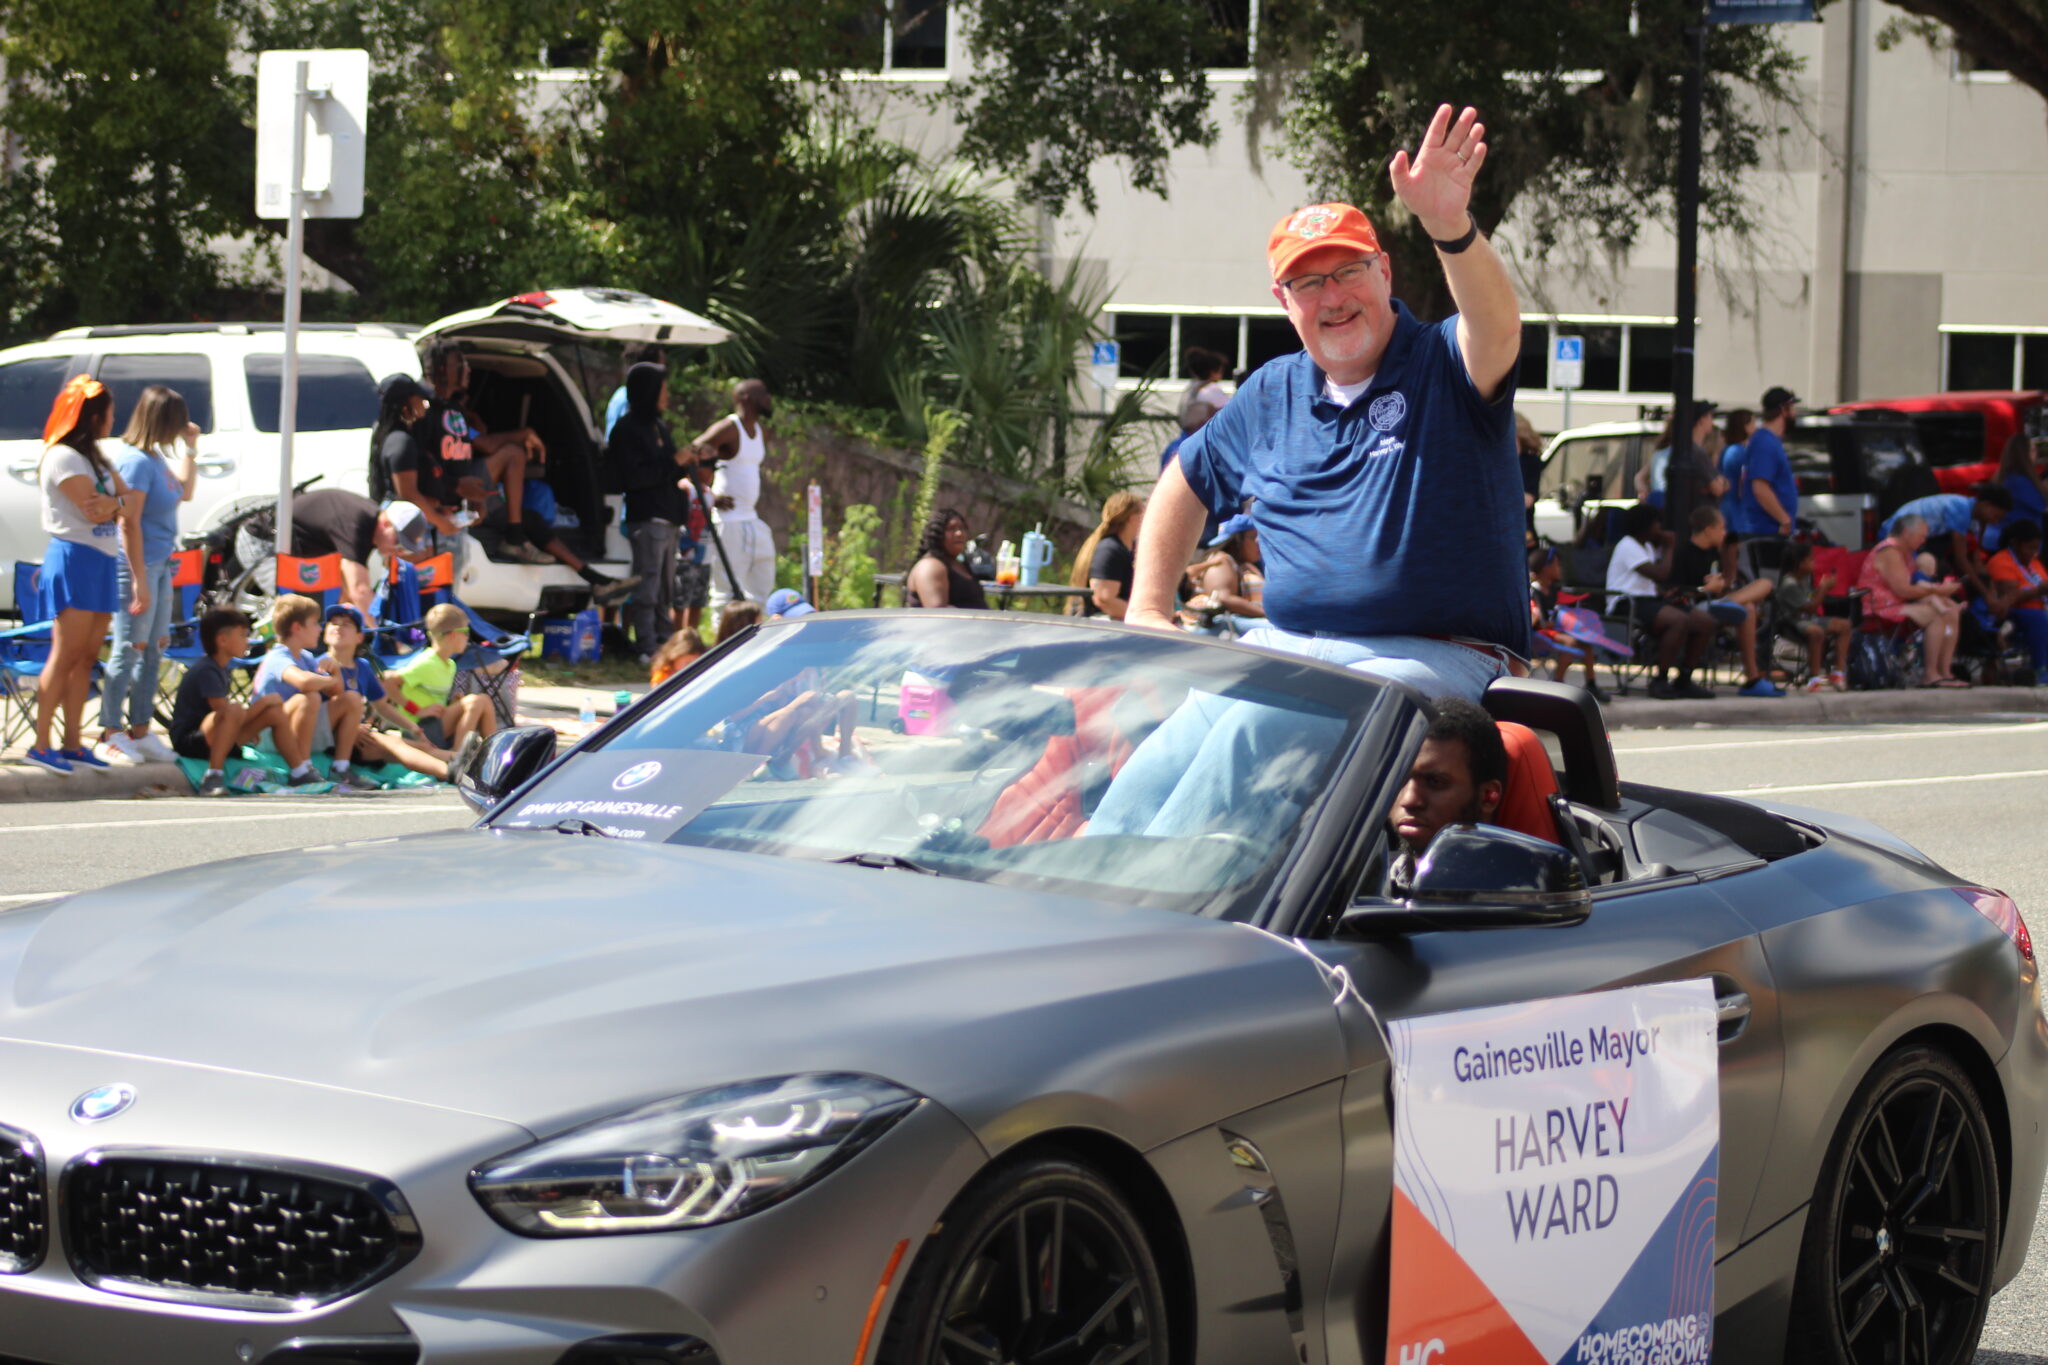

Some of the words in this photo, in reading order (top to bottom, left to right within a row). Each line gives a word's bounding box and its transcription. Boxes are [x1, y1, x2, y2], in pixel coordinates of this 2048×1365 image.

[517, 803, 558, 817] BMW
[555, 801, 580, 815] OF
[577, 801, 683, 819] GAINESVILLE
[1454, 1030, 1583, 1083] Gainesville
[1588, 1025, 1660, 1068] Mayor
[1495, 1097, 1629, 1174] HARVEY
[1506, 1174, 1619, 1244] WARD
[1576, 1314, 1697, 1362] HOMECOMING
[1647, 1335, 1709, 1365] GROWL
